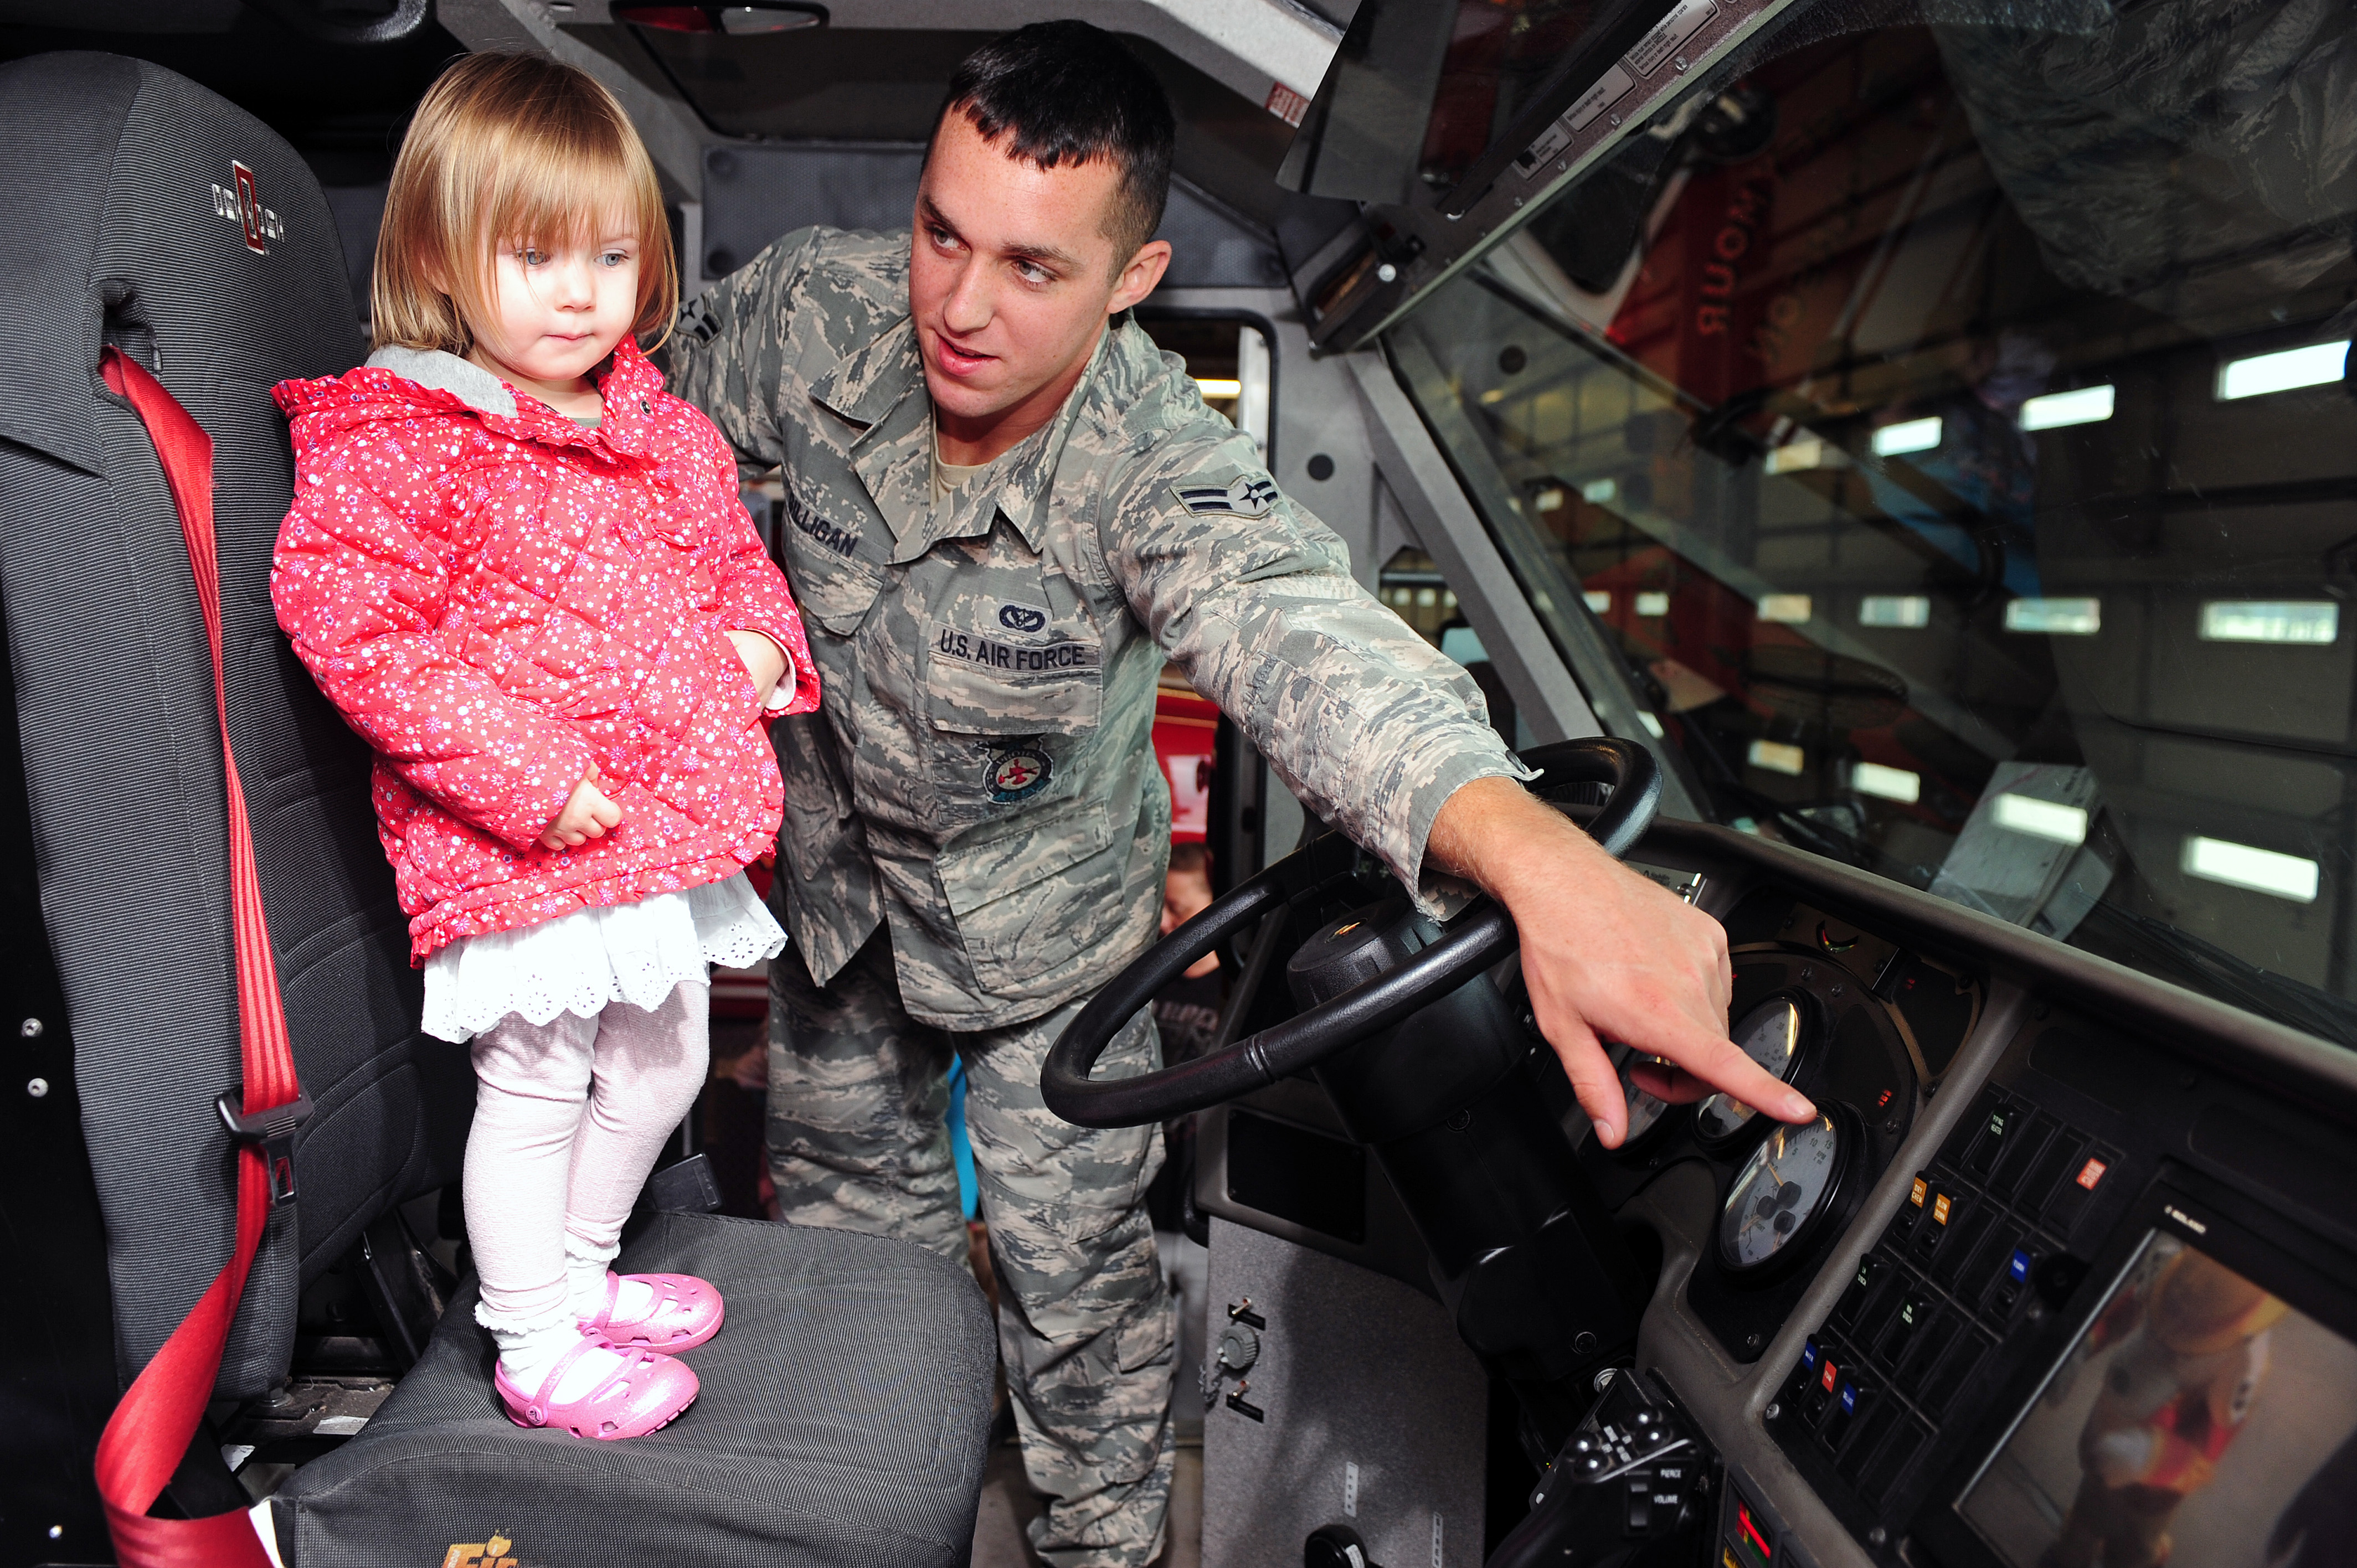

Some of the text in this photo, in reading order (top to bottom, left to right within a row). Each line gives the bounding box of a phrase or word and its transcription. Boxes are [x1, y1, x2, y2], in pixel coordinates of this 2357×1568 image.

[940, 629, 1085, 670] U.S. AIR FORCE
[1809, 1137, 1818, 1147] 10
[1824, 1139, 1833, 1150] 15
[1792, 1148, 1798, 1156] 5
[1815, 1150, 1826, 1160] RPM
[1914, 1184, 1923, 1194] DRY
[1911, 1191, 1923, 1204] CHEM
[1937, 1198, 1948, 1211] BLOW
[1934, 1209, 1946, 1221] DOWN
[1660, 1468, 1682, 1479] PIERCE
[1653, 1494, 1679, 1504] VOLUME
